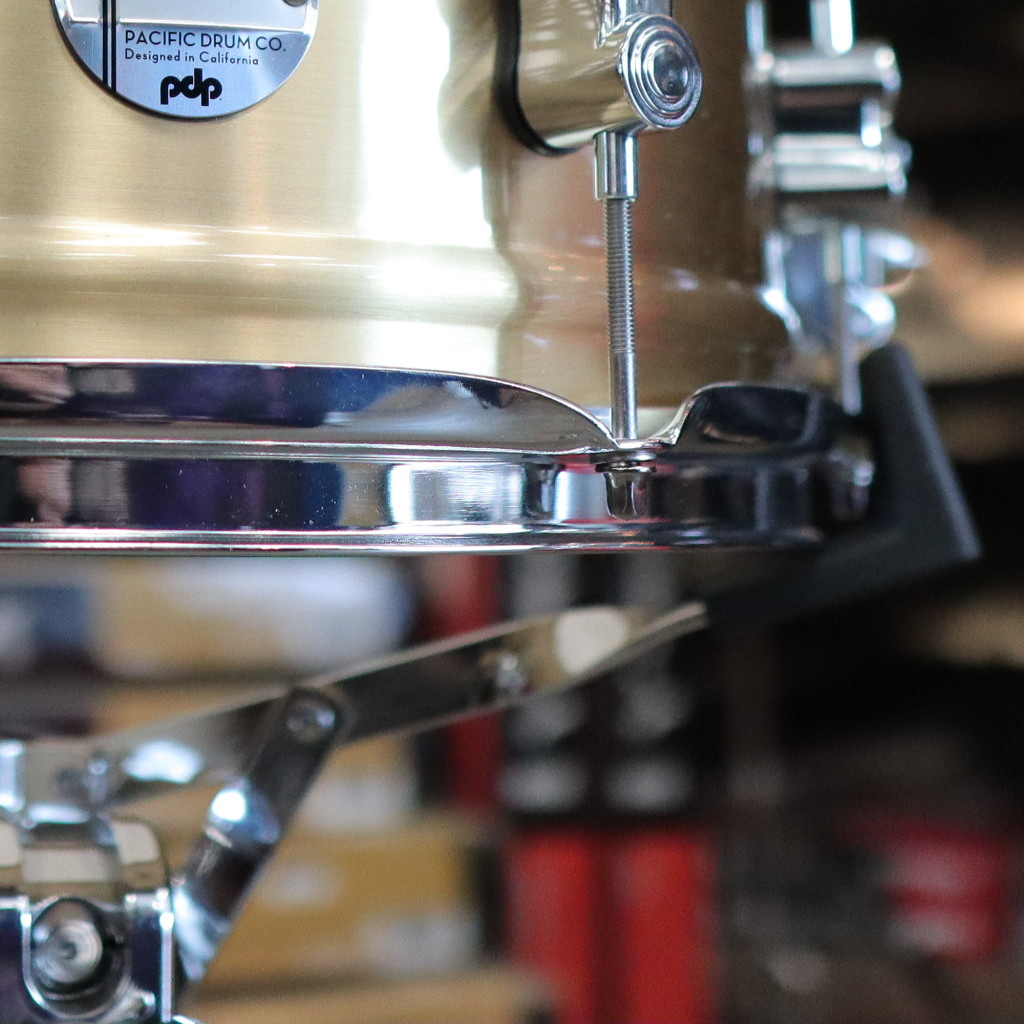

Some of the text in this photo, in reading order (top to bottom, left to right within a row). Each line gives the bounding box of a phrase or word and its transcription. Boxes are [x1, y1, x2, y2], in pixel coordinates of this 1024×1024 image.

[125, 30, 287, 52] PACIFIC DRUM CO.
[125, 48, 259, 66] Designed in California
[160, 68, 223, 106] pdp
